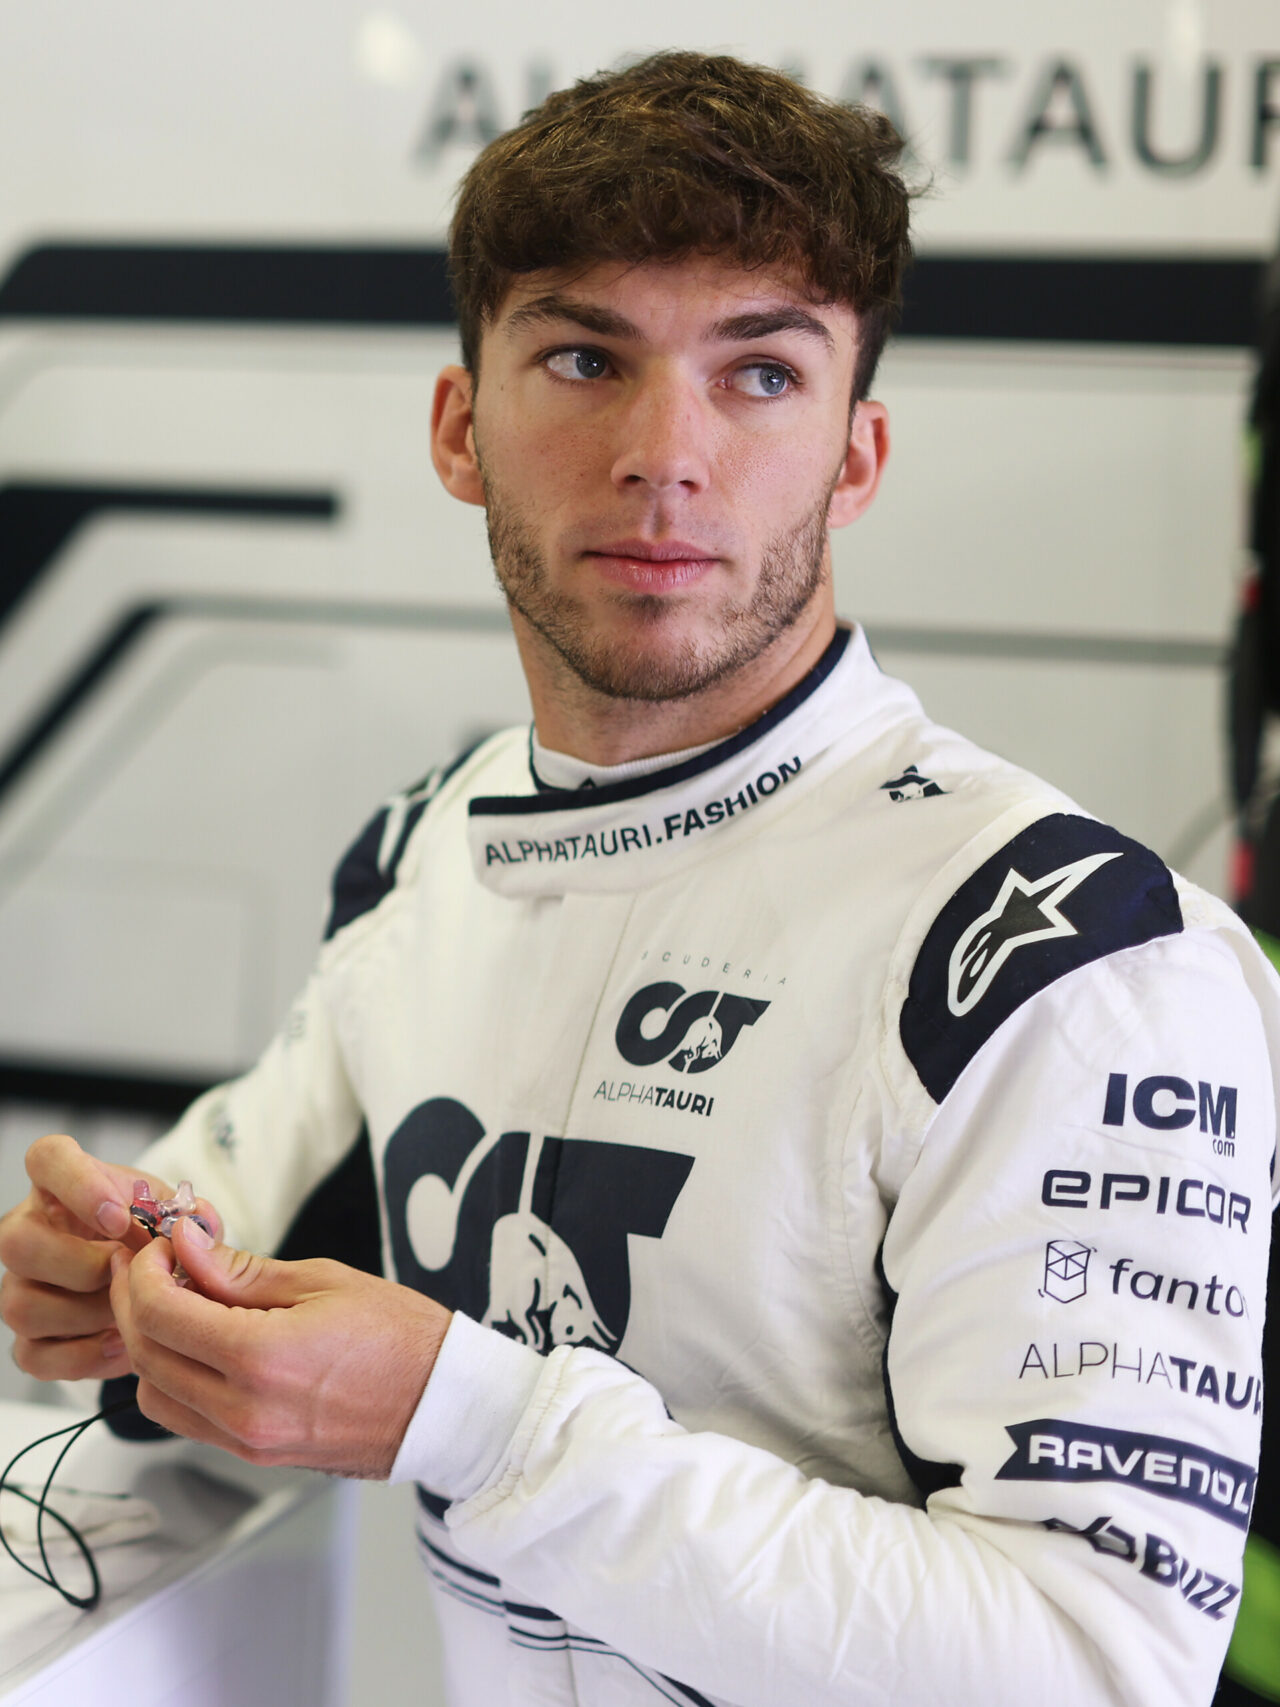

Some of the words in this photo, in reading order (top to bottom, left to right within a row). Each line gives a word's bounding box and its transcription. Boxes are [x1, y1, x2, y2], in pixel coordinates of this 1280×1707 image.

[416, 54, 1280, 176] AATAU
[485, 756, 802, 866] ALPHATAURI.FASHION
[641, 951, 788, 985] SCUDERIA
[593, 1080, 715, 1117] ALPHATAURI
[1102, 1072, 1238, 1140] ICM
[1109, 1258, 1250, 1320] fanto
[1028, 1433, 1251, 1515] RAVENOL
